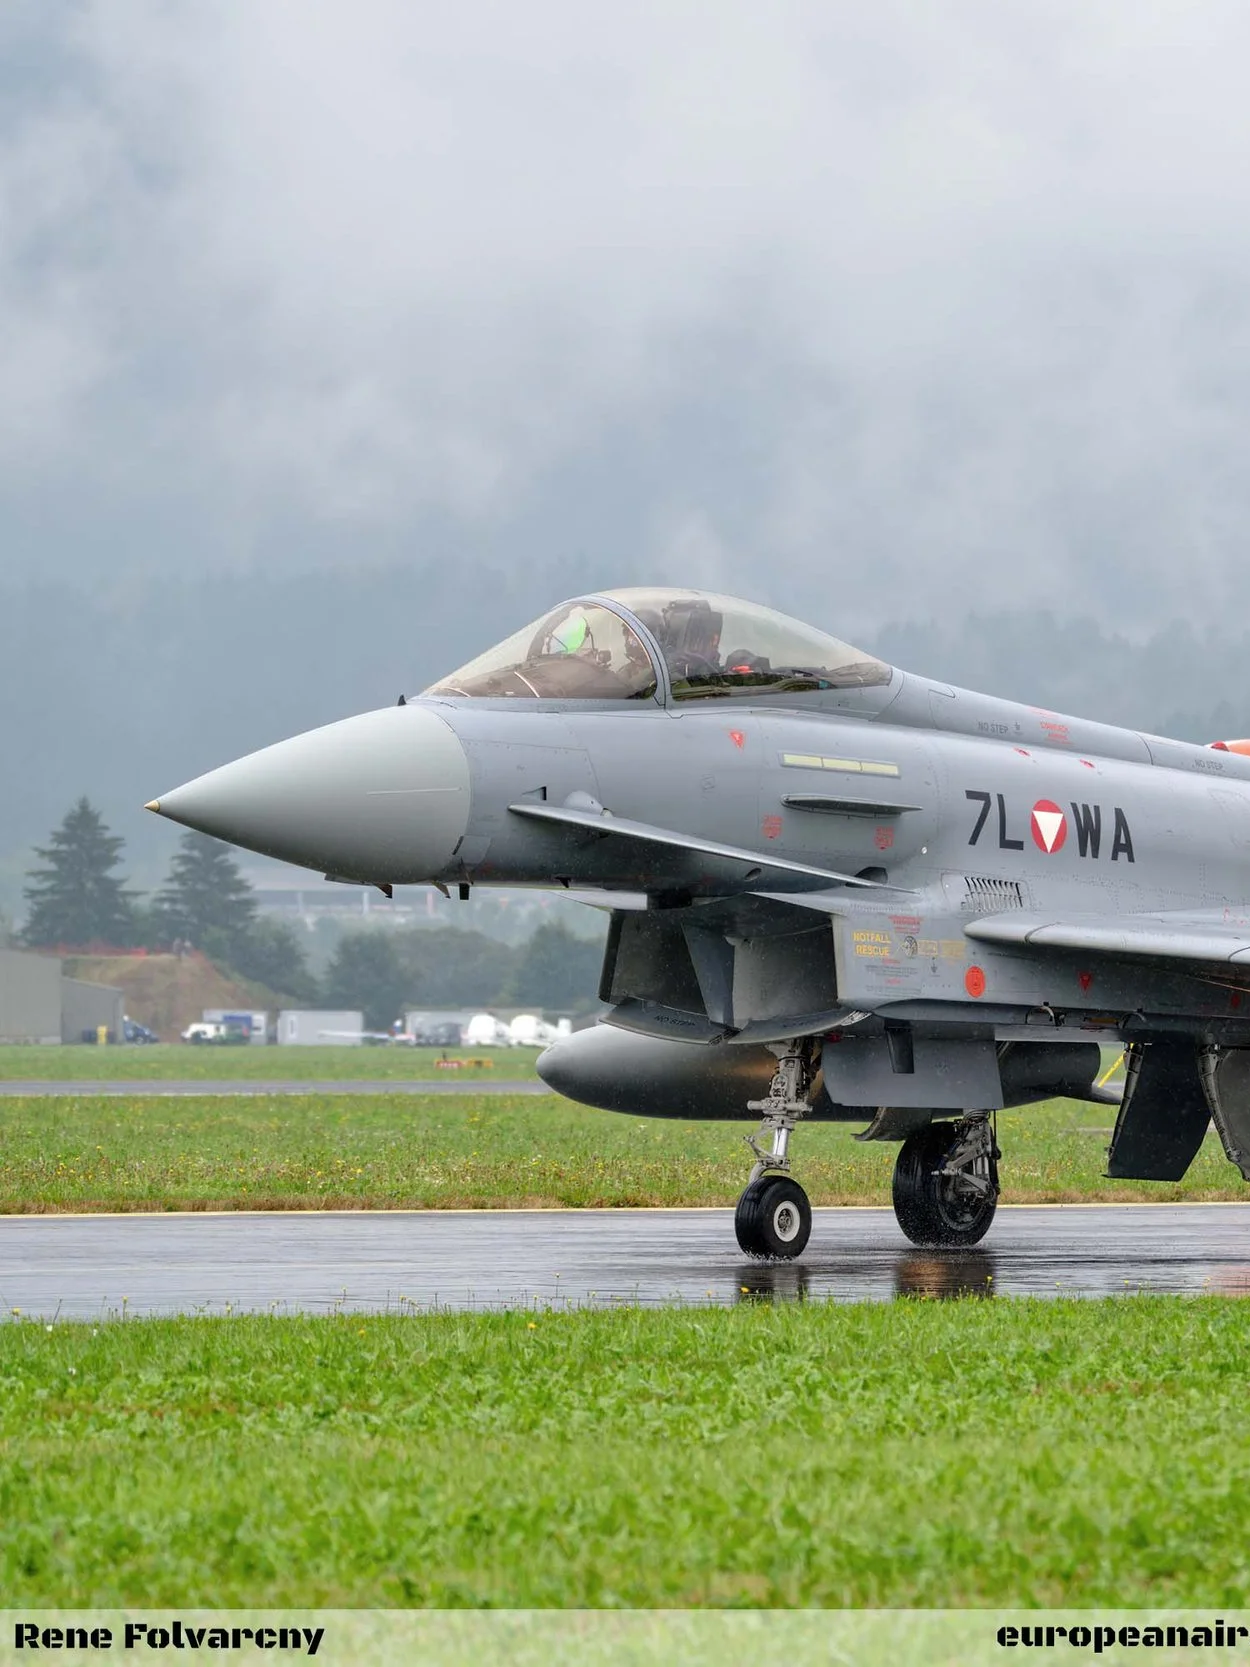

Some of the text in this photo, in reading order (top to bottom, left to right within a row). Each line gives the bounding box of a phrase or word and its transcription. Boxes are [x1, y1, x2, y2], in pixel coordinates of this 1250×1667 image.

[978, 721, 989, 732] NO
[990, 723, 1009, 734] STEP
[1195, 759, 1224, 770] NO STEP
[965, 789, 1024, 850] 7L
[1070, 802, 1135, 863] WA
[853, 931, 891, 944] NOTFALL
[856, 944, 890, 957] RESCUE
